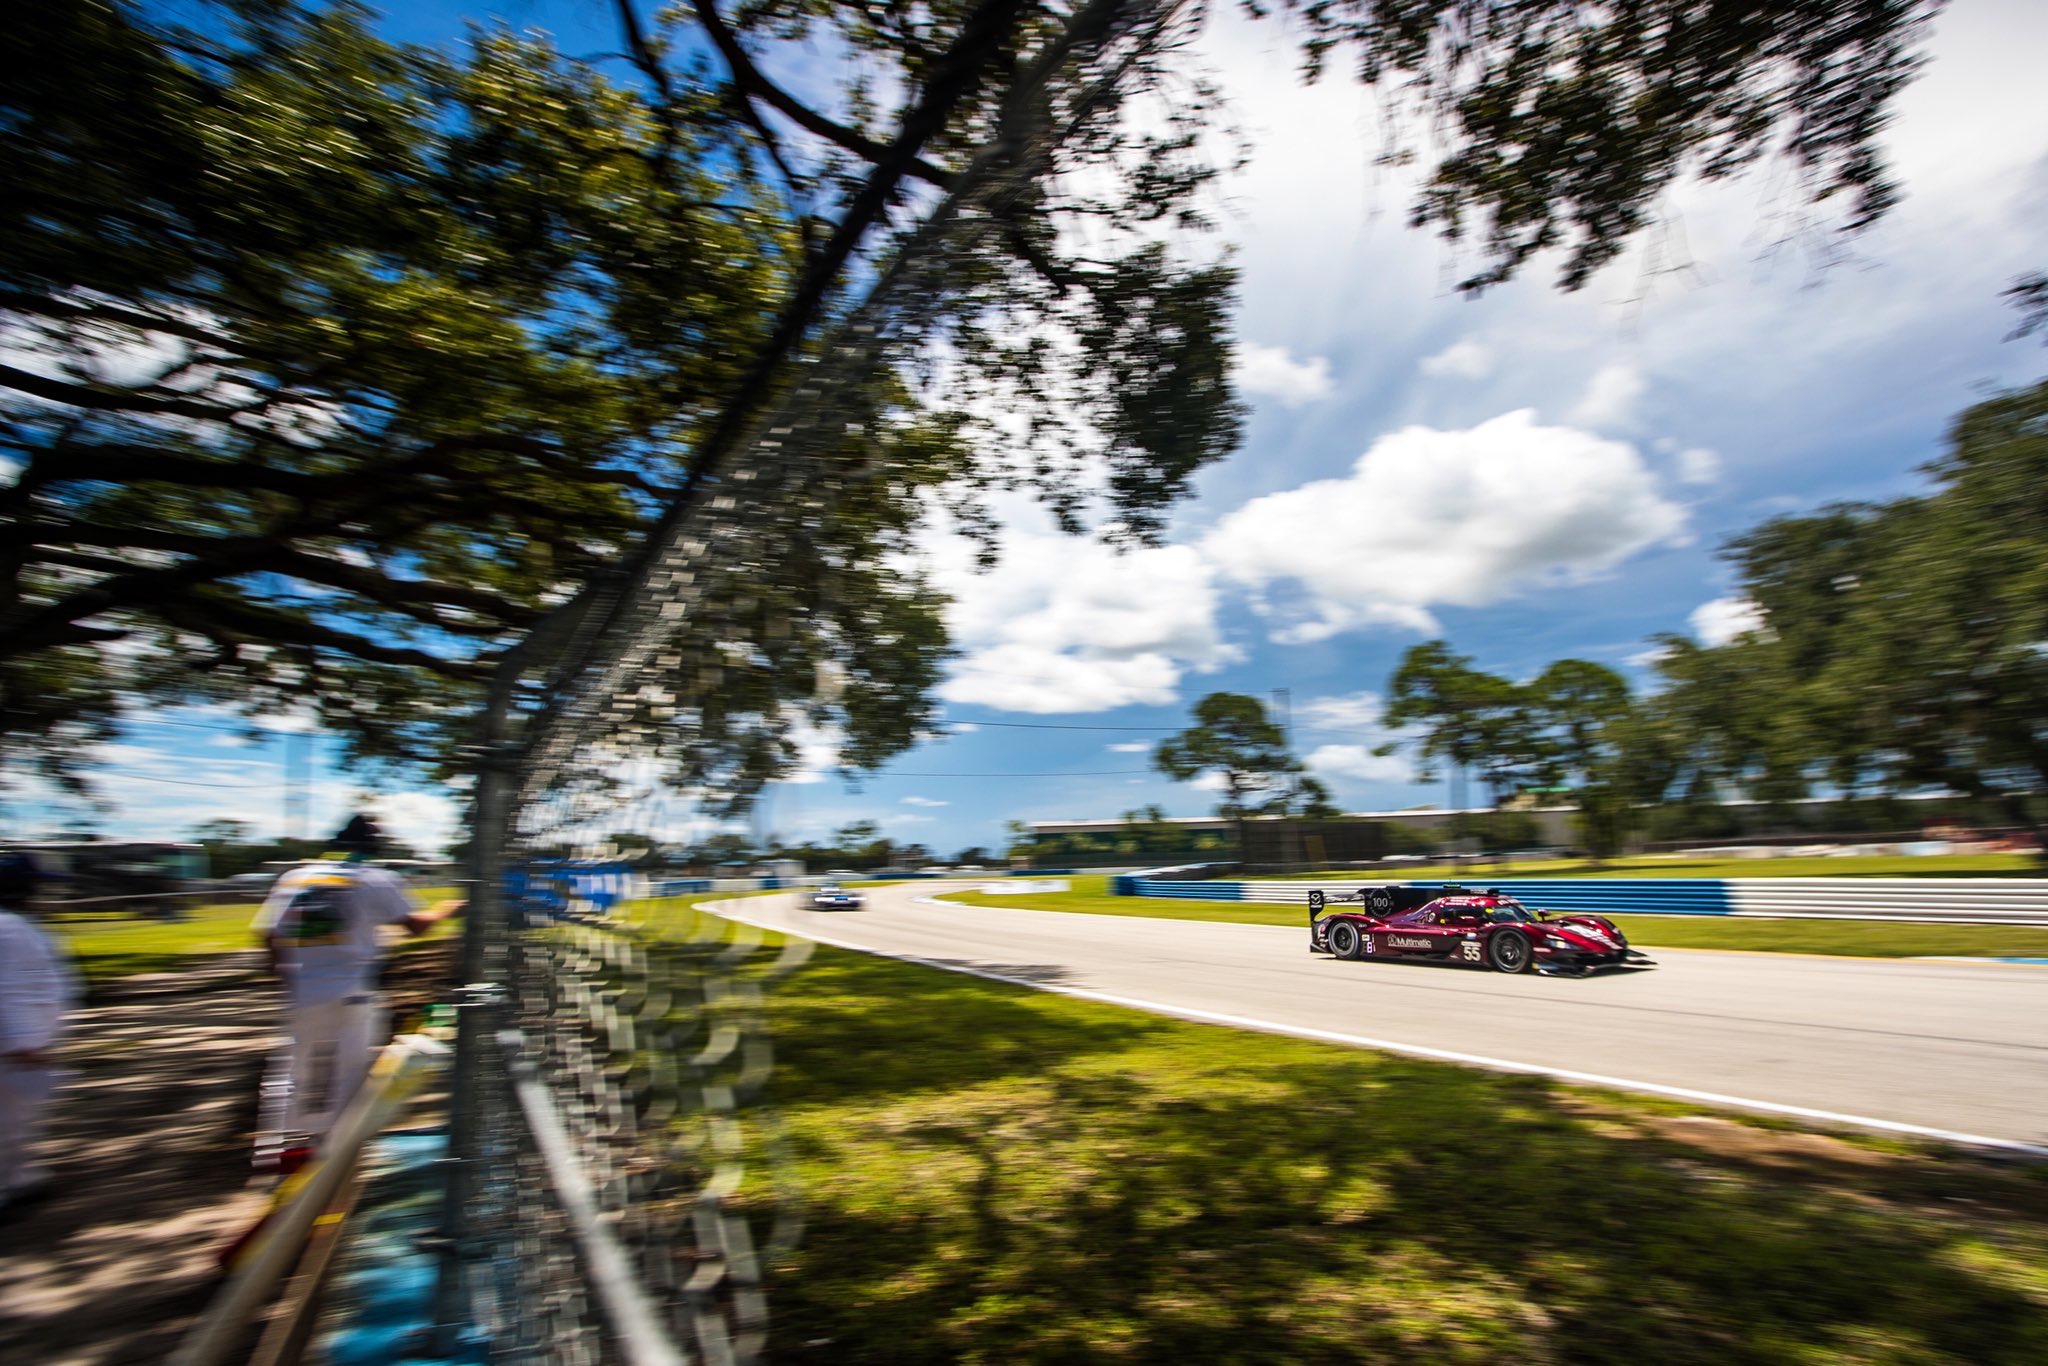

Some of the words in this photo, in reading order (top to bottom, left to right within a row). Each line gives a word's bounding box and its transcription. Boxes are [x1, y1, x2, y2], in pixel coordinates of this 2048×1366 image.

[1374, 898, 1388, 907] 100
[1397, 937, 1431, 946] Multimatic
[1464, 946, 1481, 961] 55
